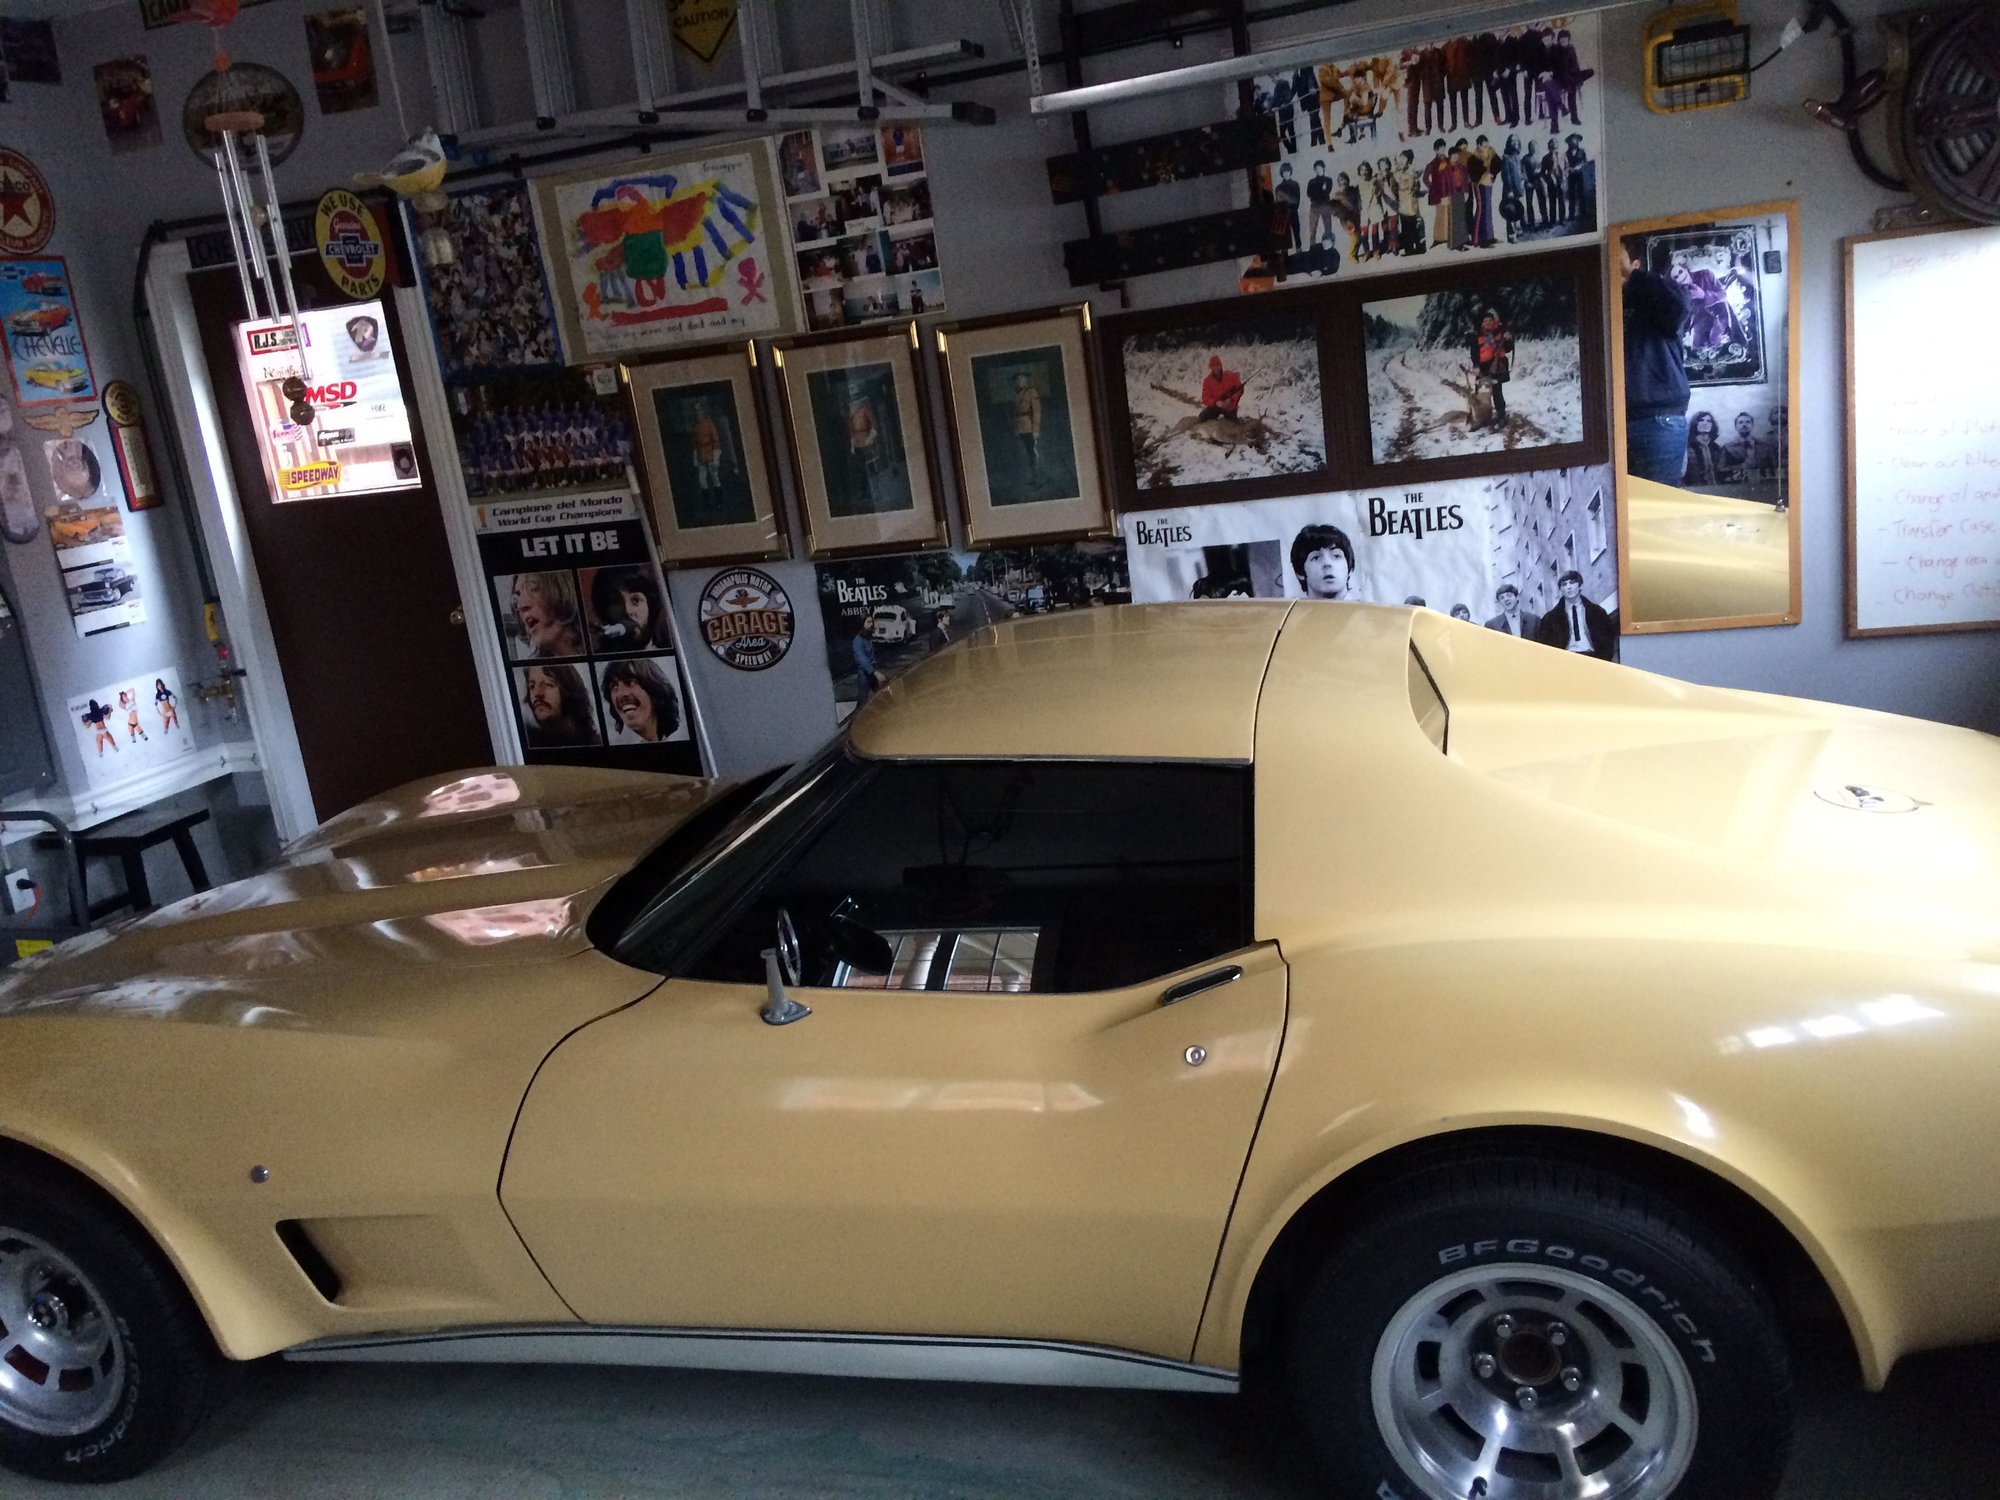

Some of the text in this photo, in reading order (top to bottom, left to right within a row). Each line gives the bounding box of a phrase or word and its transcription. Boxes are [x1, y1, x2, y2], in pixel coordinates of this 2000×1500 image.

[674, 7, 729, 29] CAUTION
[320, 193, 364, 217] WE USE
[327, 243, 377, 256] CHEVROLET
[341, 274, 380, 296] PARTS
[14, 335, 82, 362] CHEVELLE
[304, 381, 358, 404] MSD
[291, 466, 339, 485] SPEEDWAY
[492, 496, 623, 518] Campione del Mondo
[1404, 492, 1424, 504] THE
[498, 508, 623, 527] World Cup Champions
[1157, 518, 1169, 526] THE
[1368, 497, 1464, 539] BEATLES
[520, 530, 621, 558] LET IT BE
[1136, 520, 1193, 547] BEATLES
[749, 574, 774, 594] MOTOR
[855, 577, 866, 585] THE
[836, 579, 888, 606] BEATLES
[841, 606, 871, 617] ABBEY
[706, 611, 791, 643] GARAGE
[735, 636, 767, 650] Area
[734, 649, 773, 666] SPEEDWAY
[1438, 1239, 1717, 1364] BFGoodrich
